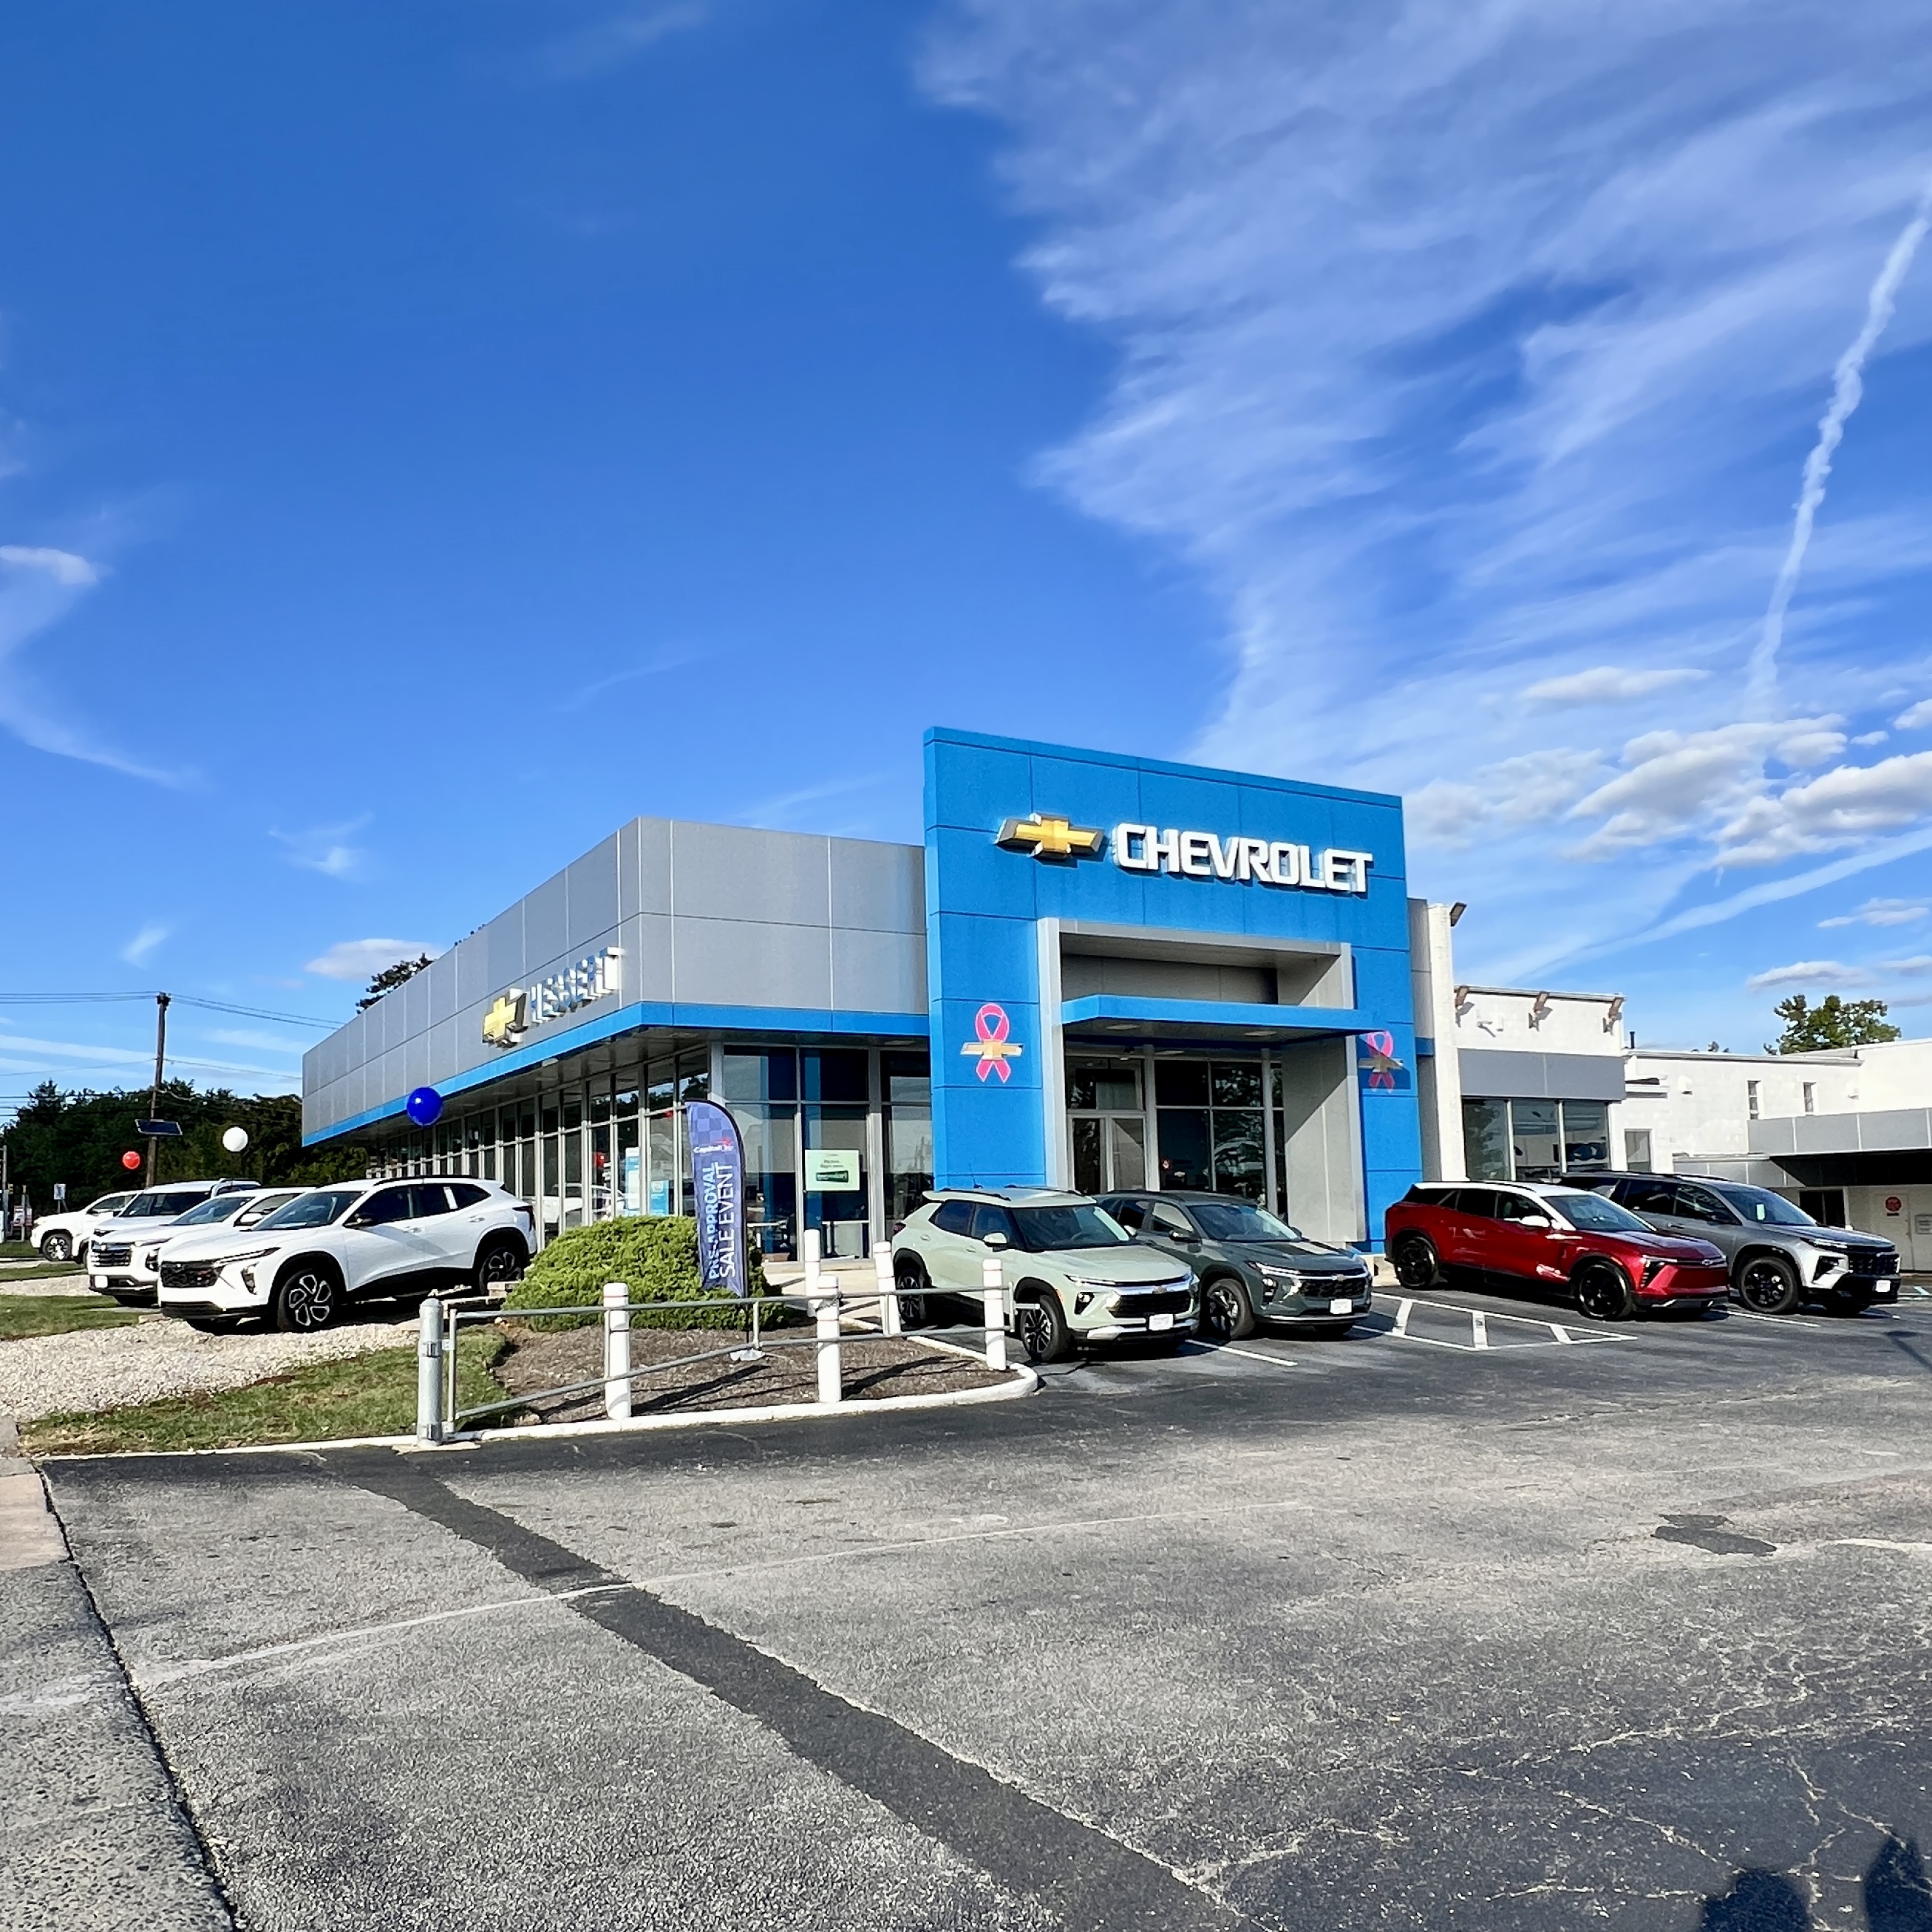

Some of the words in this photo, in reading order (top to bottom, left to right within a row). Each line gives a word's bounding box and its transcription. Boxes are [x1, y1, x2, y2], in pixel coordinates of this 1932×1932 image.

[1112, 822, 1373, 894] CHEVROLET
[715, 1161, 735, 1225] EVENT
[718, 1228, 736, 1278] SALE
